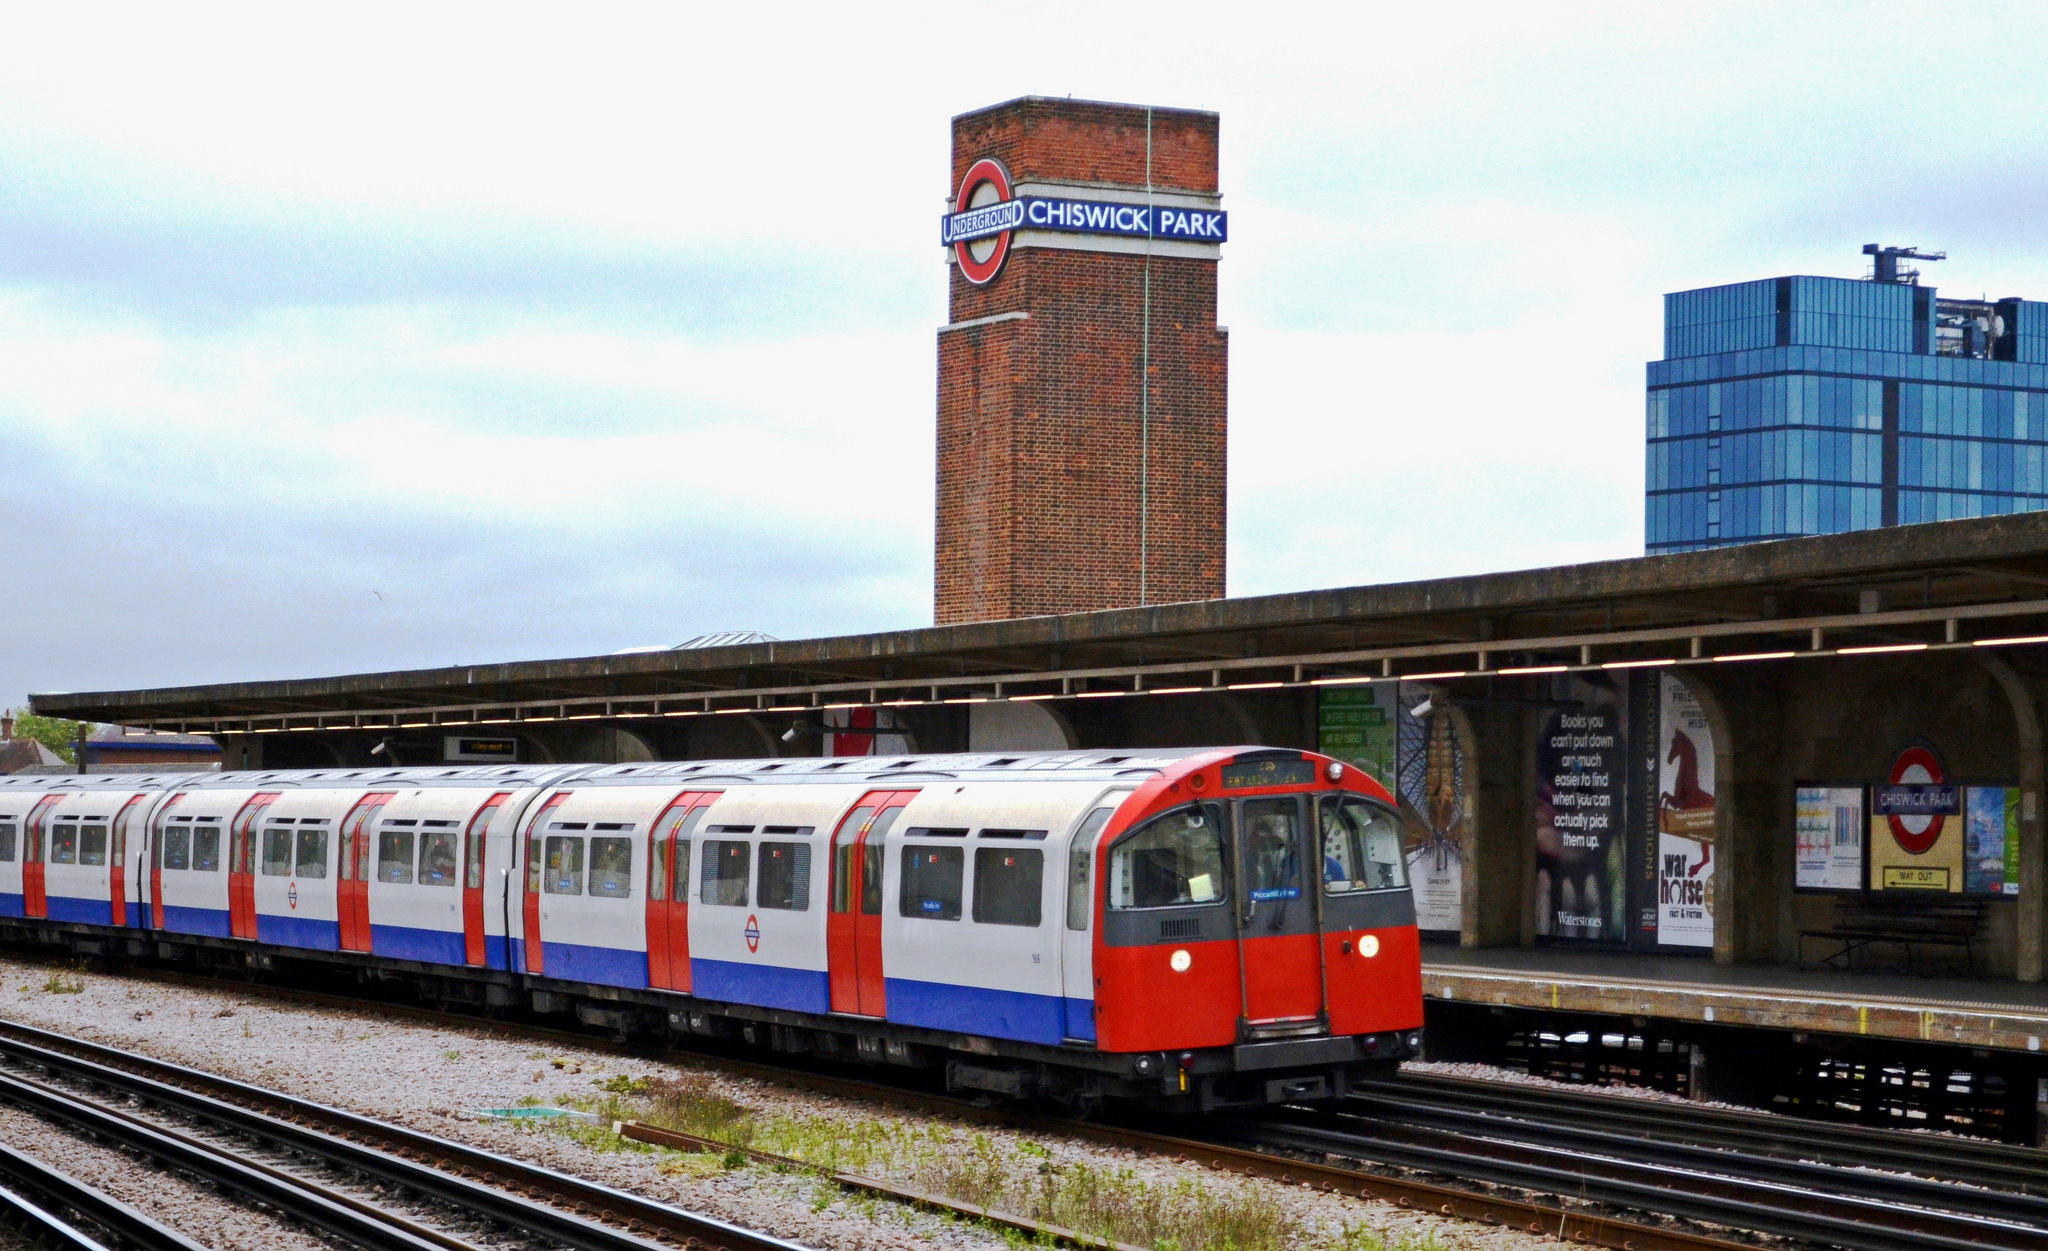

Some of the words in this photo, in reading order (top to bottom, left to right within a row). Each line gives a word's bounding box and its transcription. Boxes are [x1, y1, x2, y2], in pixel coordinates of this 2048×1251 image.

[943, 200, 1024, 242] UNDERGROUND
[1028, 201, 1149, 231] CHISWICK
[1161, 211, 1222, 237] PARK
[1561, 714, 1586, 728] Books
[1588, 716, 1603, 731] you
[1551, 733, 1572, 747] can't
[1573, 734, 1588, 750] put
[1589, 733, 1614, 747] down
[1577, 753, 1601, 767] much
[1581, 772, 1590, 786] to
[1592, 772, 1608, 786] find
[1552, 791, 1575, 805] when
[1577, 794, 1592, 809] you
[1593, 795, 1611, 806] can
[1881, 793, 1926, 806] CHISWICK
[1930, 793, 1953, 807] PARK
[1554, 812, 1588, 830] actually
[1589, 813, 1608, 830] pick
[1645, 775, 1654, 881] EXHIBITIONS
[1563, 832, 1585, 846] them
[1586, 836, 1599, 850] up.
[1664, 854, 1687, 878] war
[1900, 872, 1914, 880] WAY
[1918, 872, 1933, 881] OUT
[1660, 870, 1704, 905] horse
[1558, 911, 1602, 928] Waterstones
[1681, 908, 1686, 919] &
